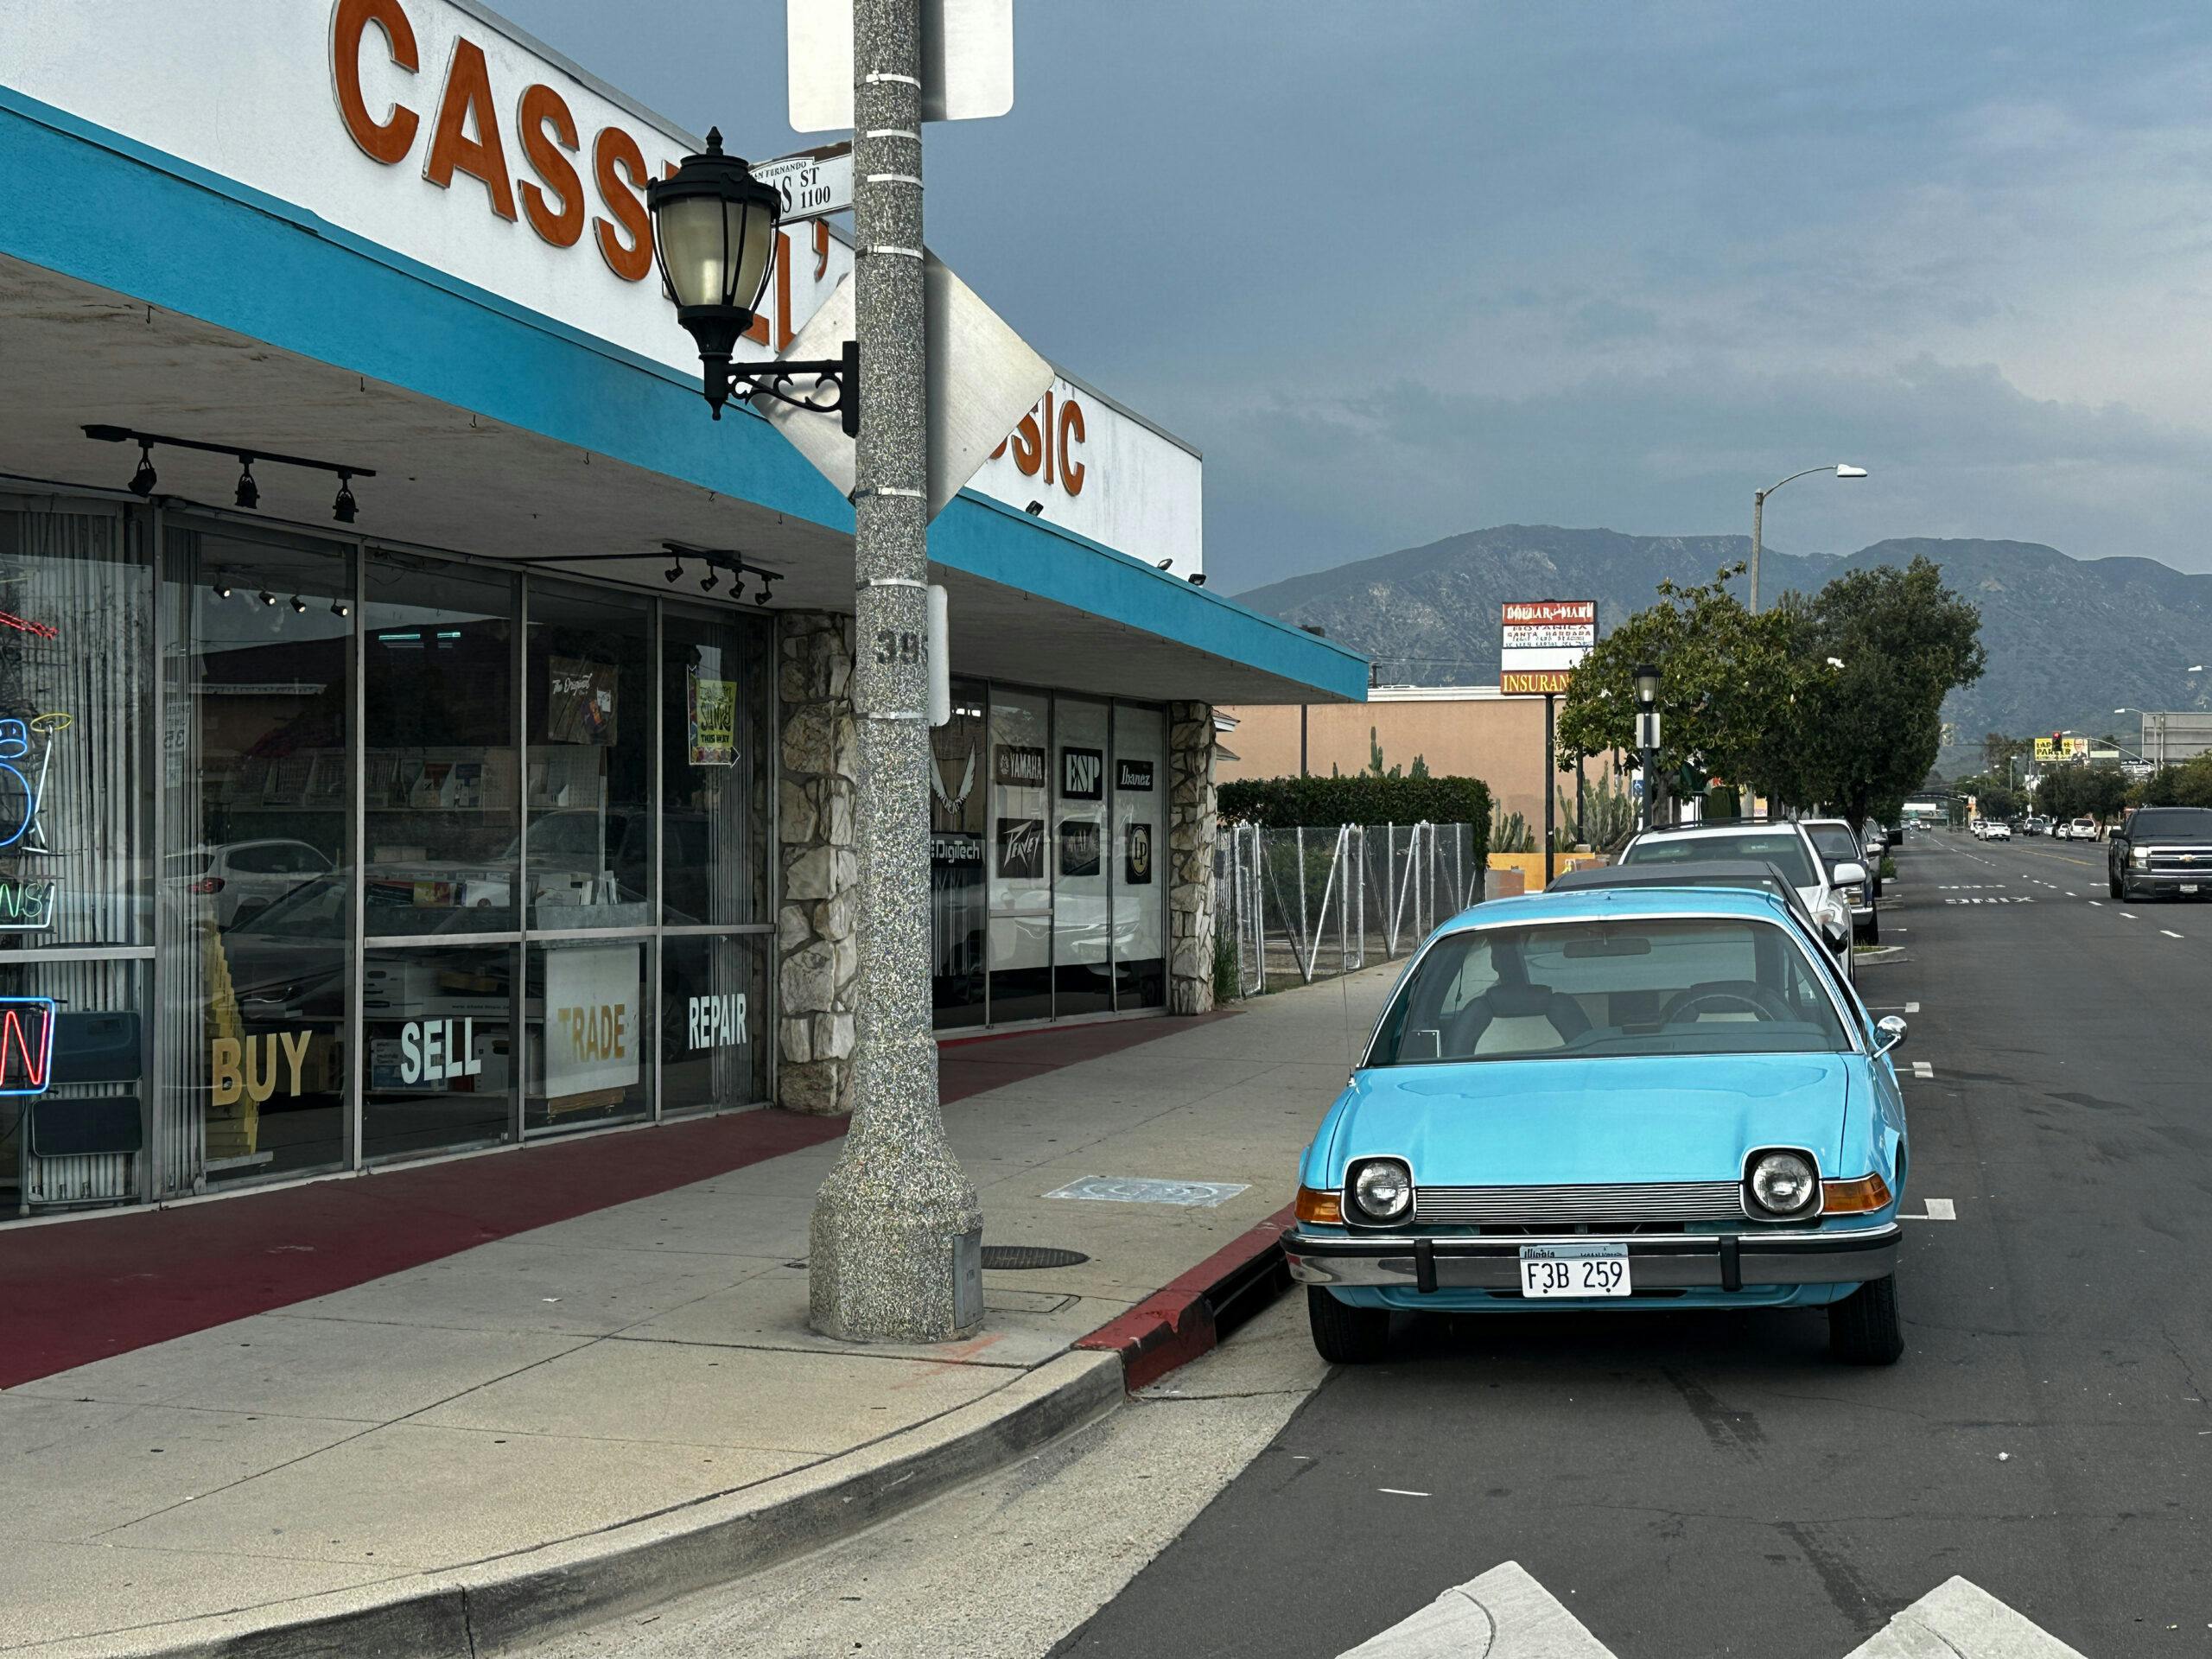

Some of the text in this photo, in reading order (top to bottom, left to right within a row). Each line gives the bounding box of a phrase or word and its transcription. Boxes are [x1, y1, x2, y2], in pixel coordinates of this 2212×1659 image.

[766, 161, 807, 178] FERNANDO
[800, 167, 820, 188] ST
[801, 186, 830, 209] 1100
[1503, 674, 1570, 693] INSURAN
[1010, 753, 1042, 780] YAMAHA
[1065, 753, 1101, 793] ESP
[1121, 765, 1151, 786] Ibanez
[1134, 836, 1147, 866] LP
[557, 1003, 626, 1063] TRADE
[689, 993, 747, 1051] REPAIR
[400, 1017, 482, 1084] SELL
[212, 1029, 313, 1107] BUY
[1527, 1261, 1624, 1289] F3B 259
